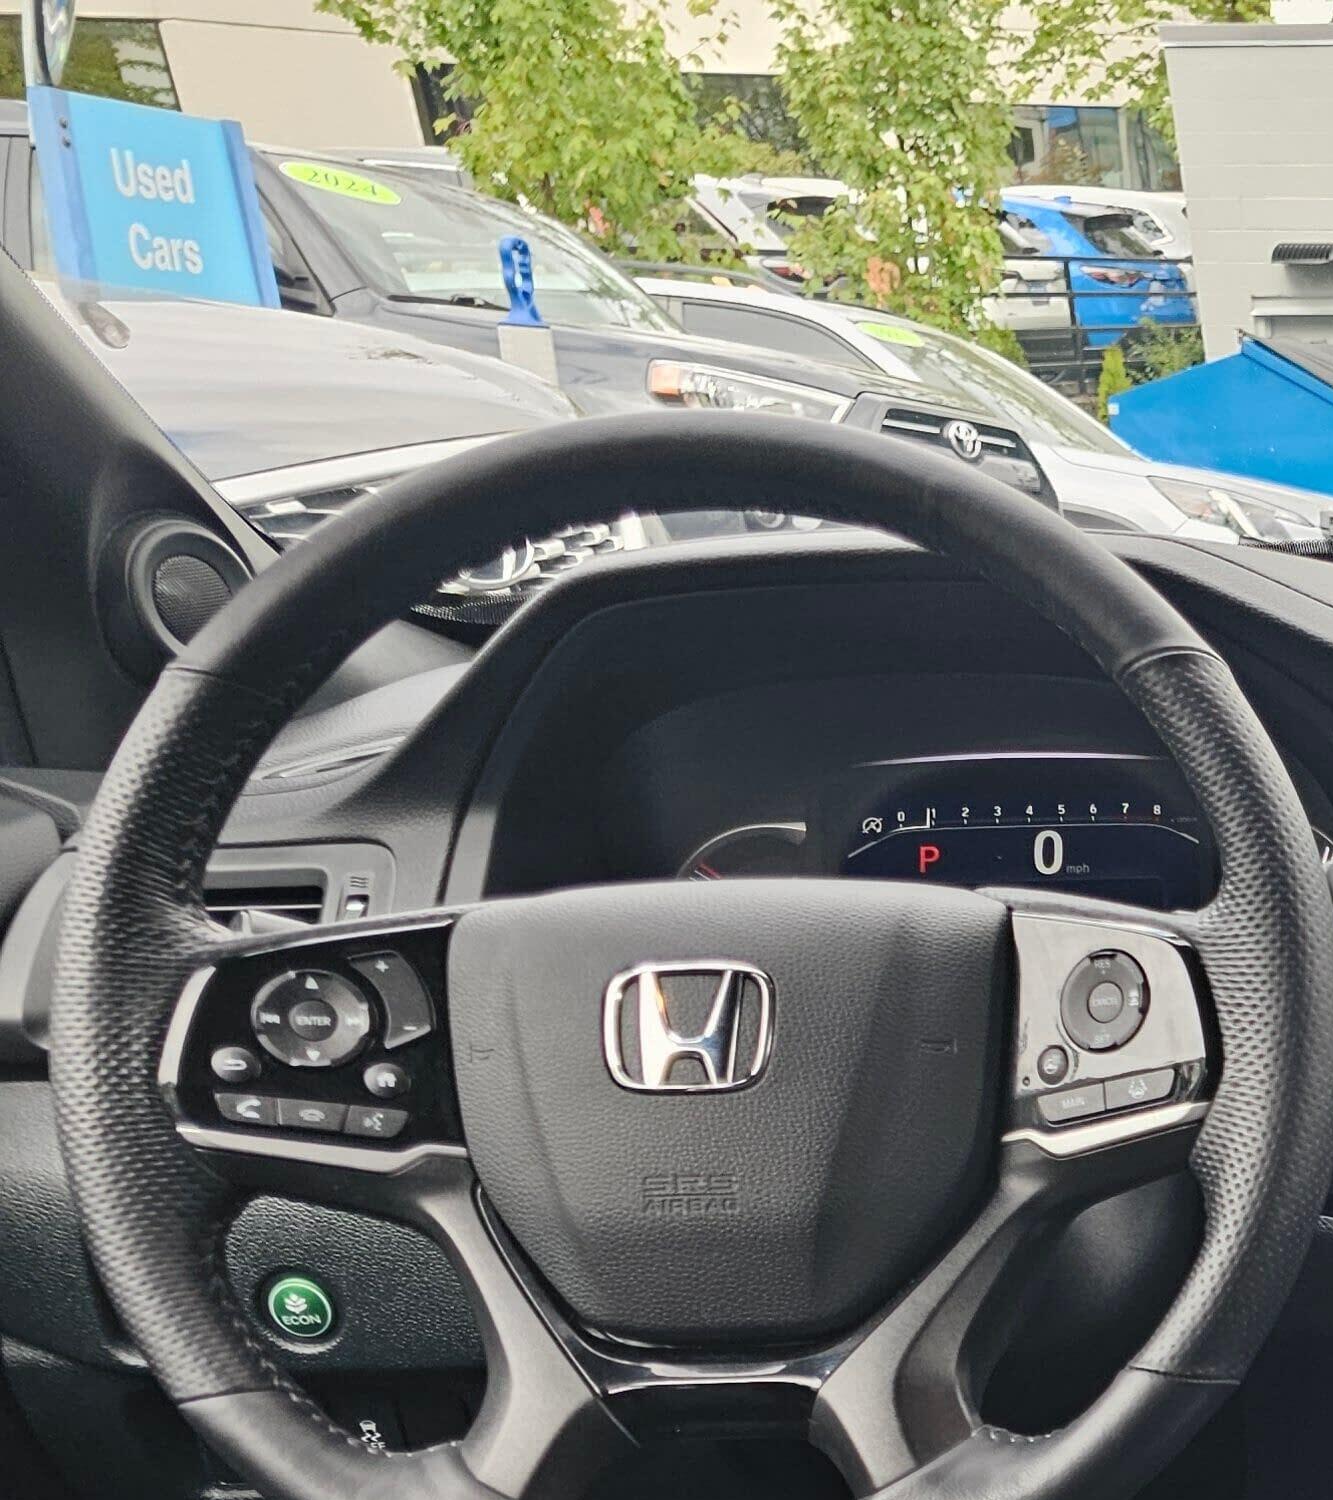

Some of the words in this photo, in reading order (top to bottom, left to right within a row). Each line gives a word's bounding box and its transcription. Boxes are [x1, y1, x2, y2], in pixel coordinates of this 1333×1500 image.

[109, 147, 196, 204] Used
[308, 170, 377, 196] 2024
[127, 222, 205, 275] Cars
[961, 807, 970, 818] 2
[993, 805, 1002, 817] 3
[1025, 804, 1033, 815] 4
[1057, 804, 1066, 815] 5
[1089, 803, 1097, 814] 6
[1122, 803, 1129, 814] 7
[1153, 804, 1162, 816] 8
[896, 811, 905, 822] 0
[1033, 829, 1064, 876] 0
[1066, 863, 1090, 875] mph
[919, 846, 941, 873] P
[295, 1015, 332, 1027] ENTER
[281, 1314, 322, 1326] ECON
